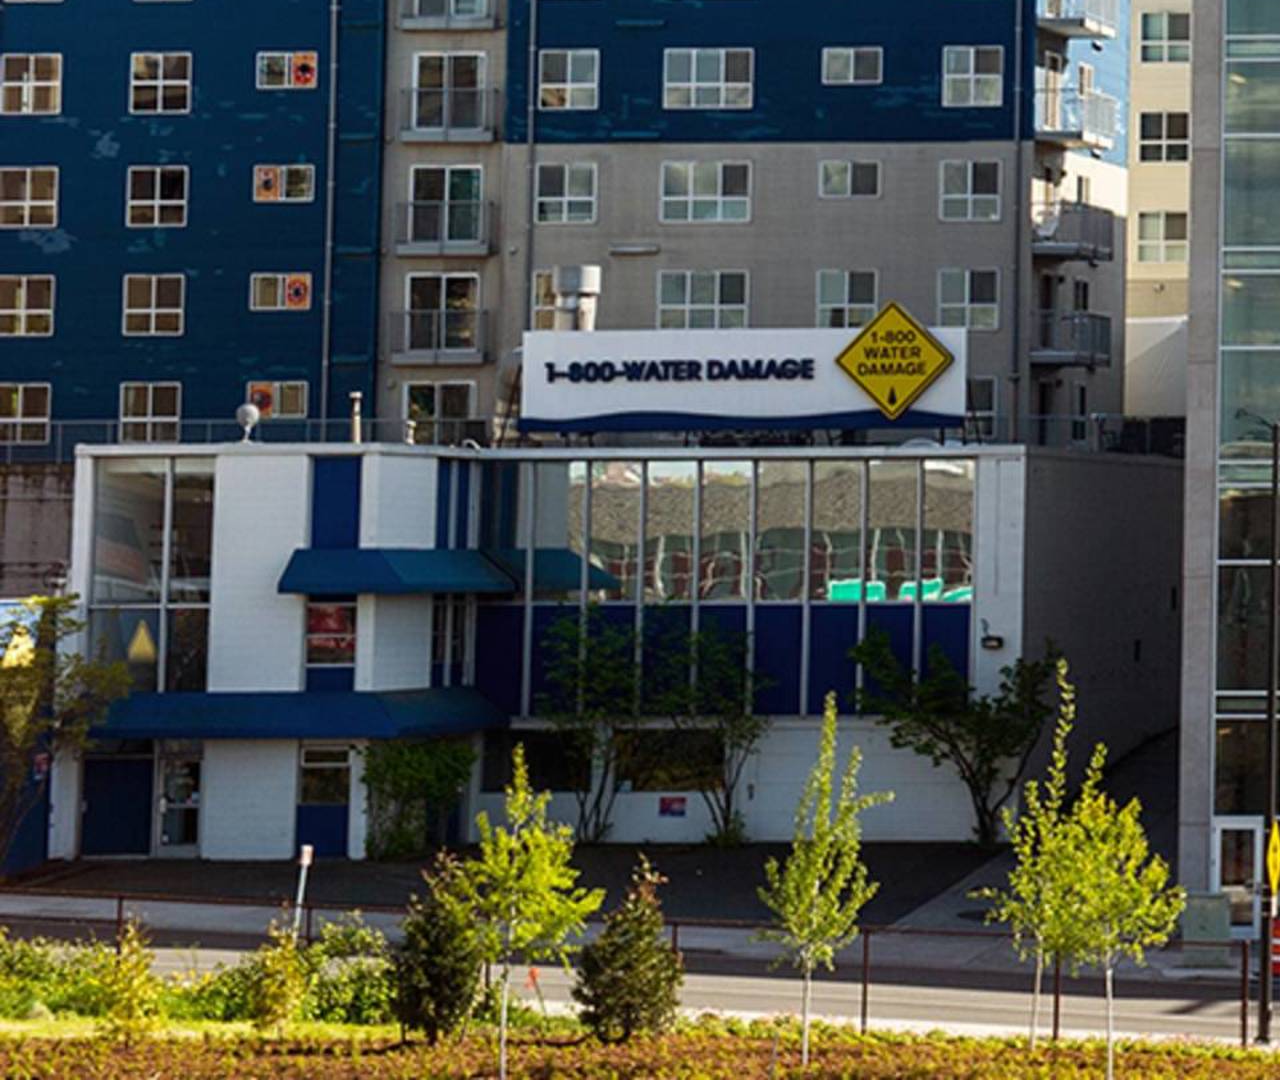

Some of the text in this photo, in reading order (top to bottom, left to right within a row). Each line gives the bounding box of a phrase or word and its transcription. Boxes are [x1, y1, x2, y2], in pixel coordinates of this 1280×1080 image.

[871, 330, 916, 344] 1-800
[864, 346, 921, 359] WATER
[544, 359, 814, 383] 1-800-WATER DAMAGE
[858, 362, 926, 376] DAMAGE
